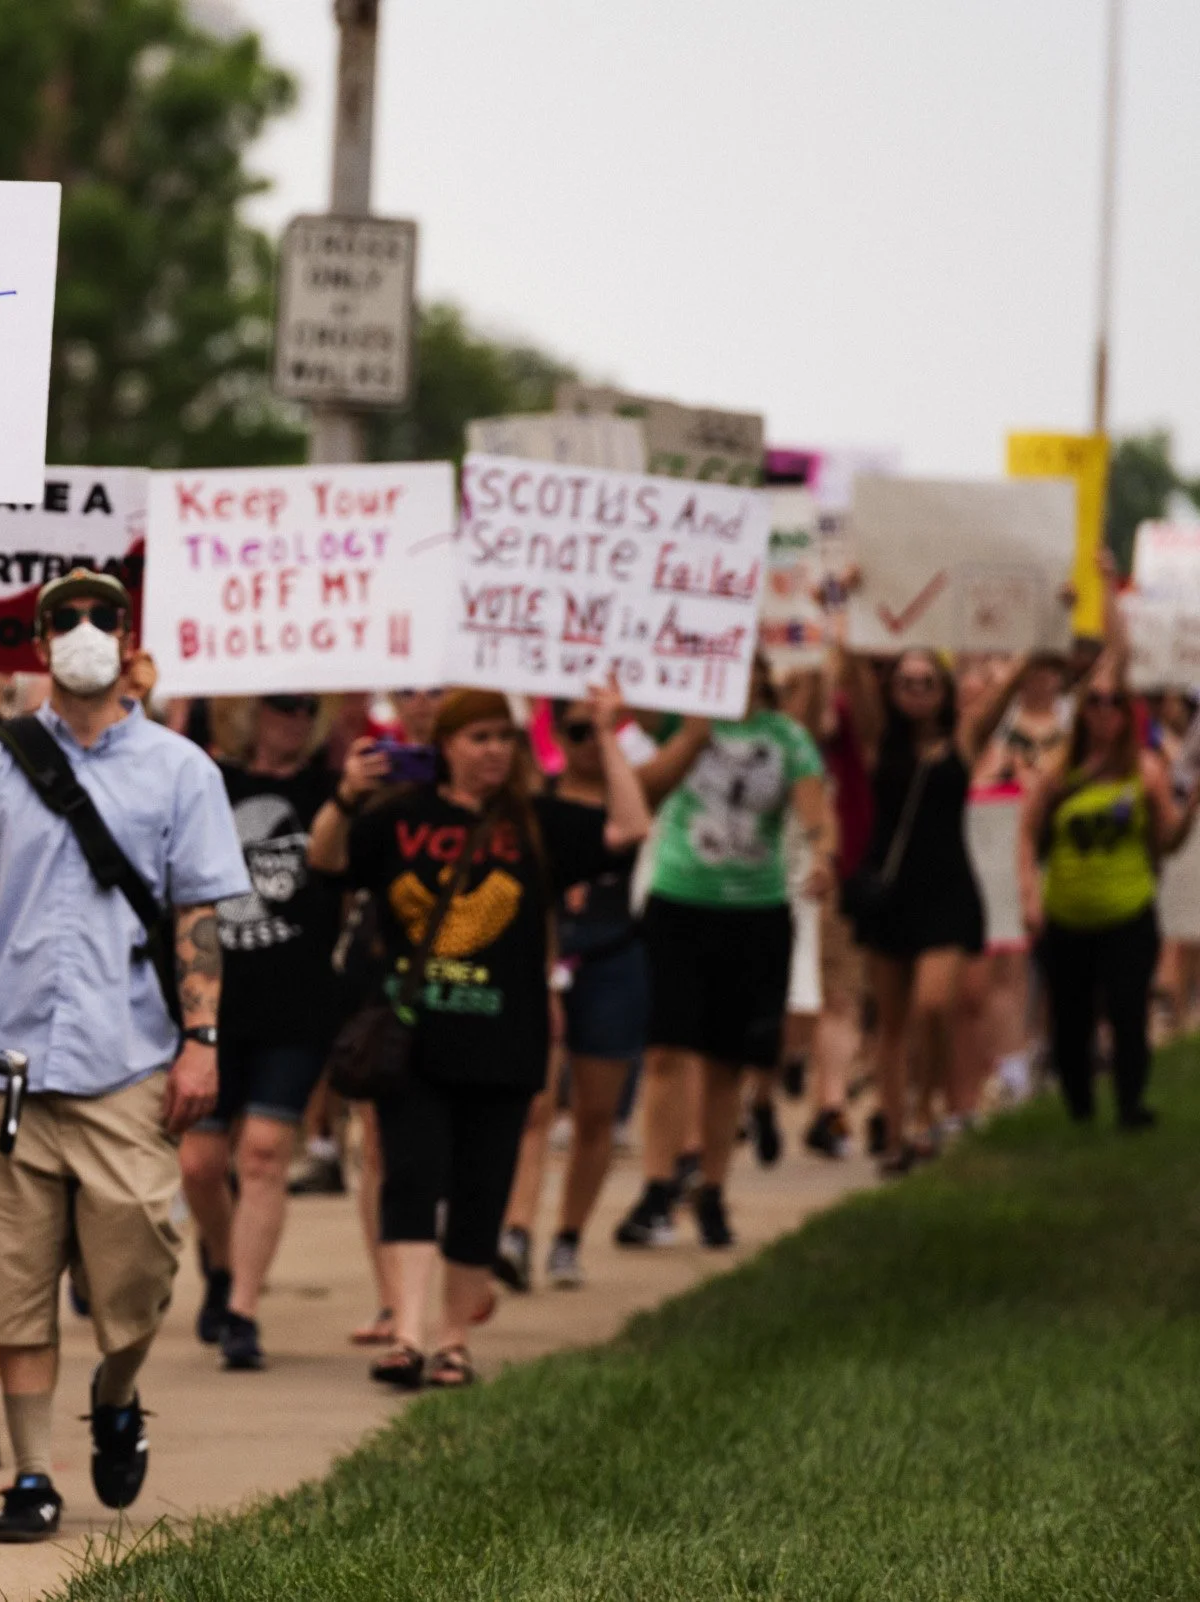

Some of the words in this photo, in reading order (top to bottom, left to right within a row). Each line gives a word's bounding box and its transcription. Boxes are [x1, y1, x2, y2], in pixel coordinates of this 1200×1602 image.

[477, 467, 661, 532] SCOTUS
[222, 568, 299, 614] OFF
[321, 568, 373, 606] MY
[394, 820, 521, 864] VOE
